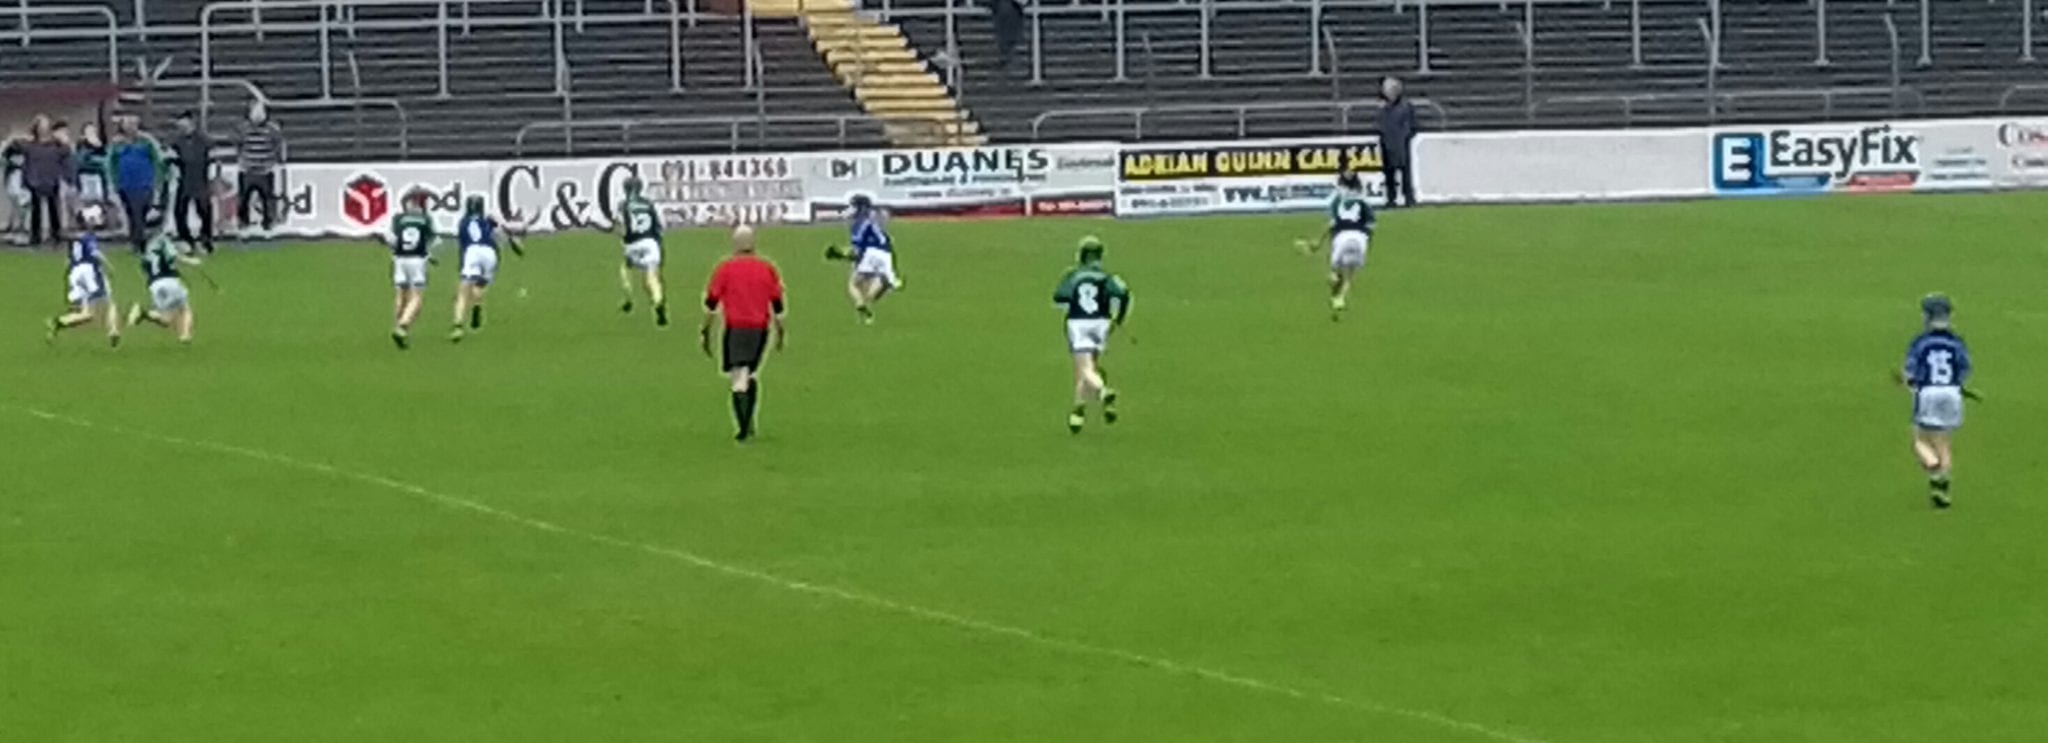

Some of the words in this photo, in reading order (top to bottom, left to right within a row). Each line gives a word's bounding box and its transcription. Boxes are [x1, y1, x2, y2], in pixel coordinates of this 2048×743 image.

[882, 149, 1048, 175] DUANES
[1125, 151, 1208, 176] ADRIAN
[1215, 149, 1291, 173] QUINN
[1296, 146, 1341, 170] CAR
[1770, 125, 1918, 178] EasyFix
[498, 164, 541, 227] C
[550, 181, 612, 232] &
[401, 226, 420, 251] 9
[1078, 282, 1099, 314] 8
[1926, 349, 1953, 384] 15
